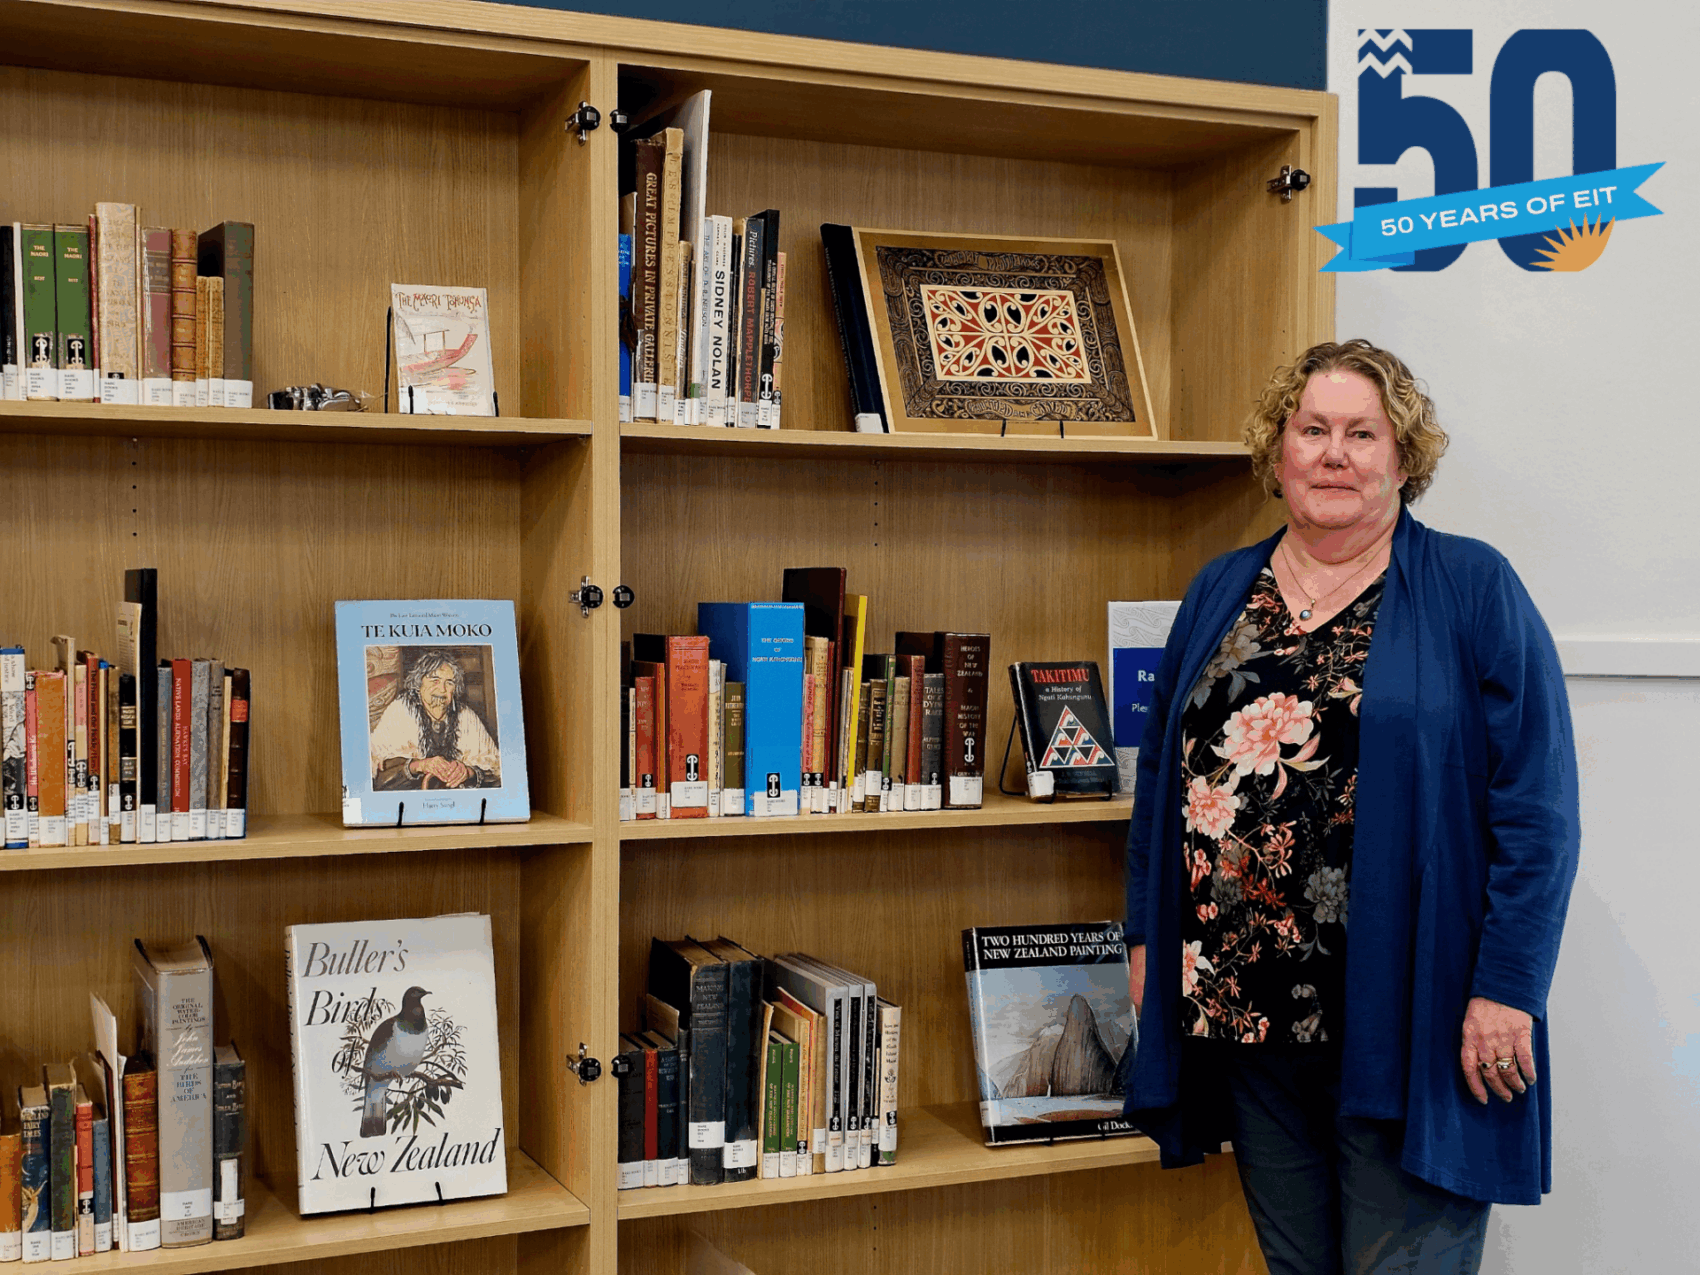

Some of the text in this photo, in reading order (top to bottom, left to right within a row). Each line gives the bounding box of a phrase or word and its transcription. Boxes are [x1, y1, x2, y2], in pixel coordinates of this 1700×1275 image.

[645, 172, 658, 384] GREAT PICTURES IN PRIVATE GALLERIE
[746, 272, 756, 314] ROBERT
[712, 270, 725, 390] SIDNEY NOLAN
[360, 624, 492, 638] TE KUIA MOKO
[1031, 668, 1090, 683] TAKITIMU
[1138, 670, 1155, 682] Ra
[1132, 703, 1149, 713] Ple
[981, 931, 1122, 947] TWO HUNDRED YEARS OF
[983, 943, 1123, 960] NEW ZEALAND PAINTING
[302, 940, 409, 978] Buller's
[305, 986, 384, 1027] Birds
[331, 1040, 358, 1079] of
[1110, 1121, 1134, 1130] Dock
[310, 1127, 502, 1181] New Zealand
